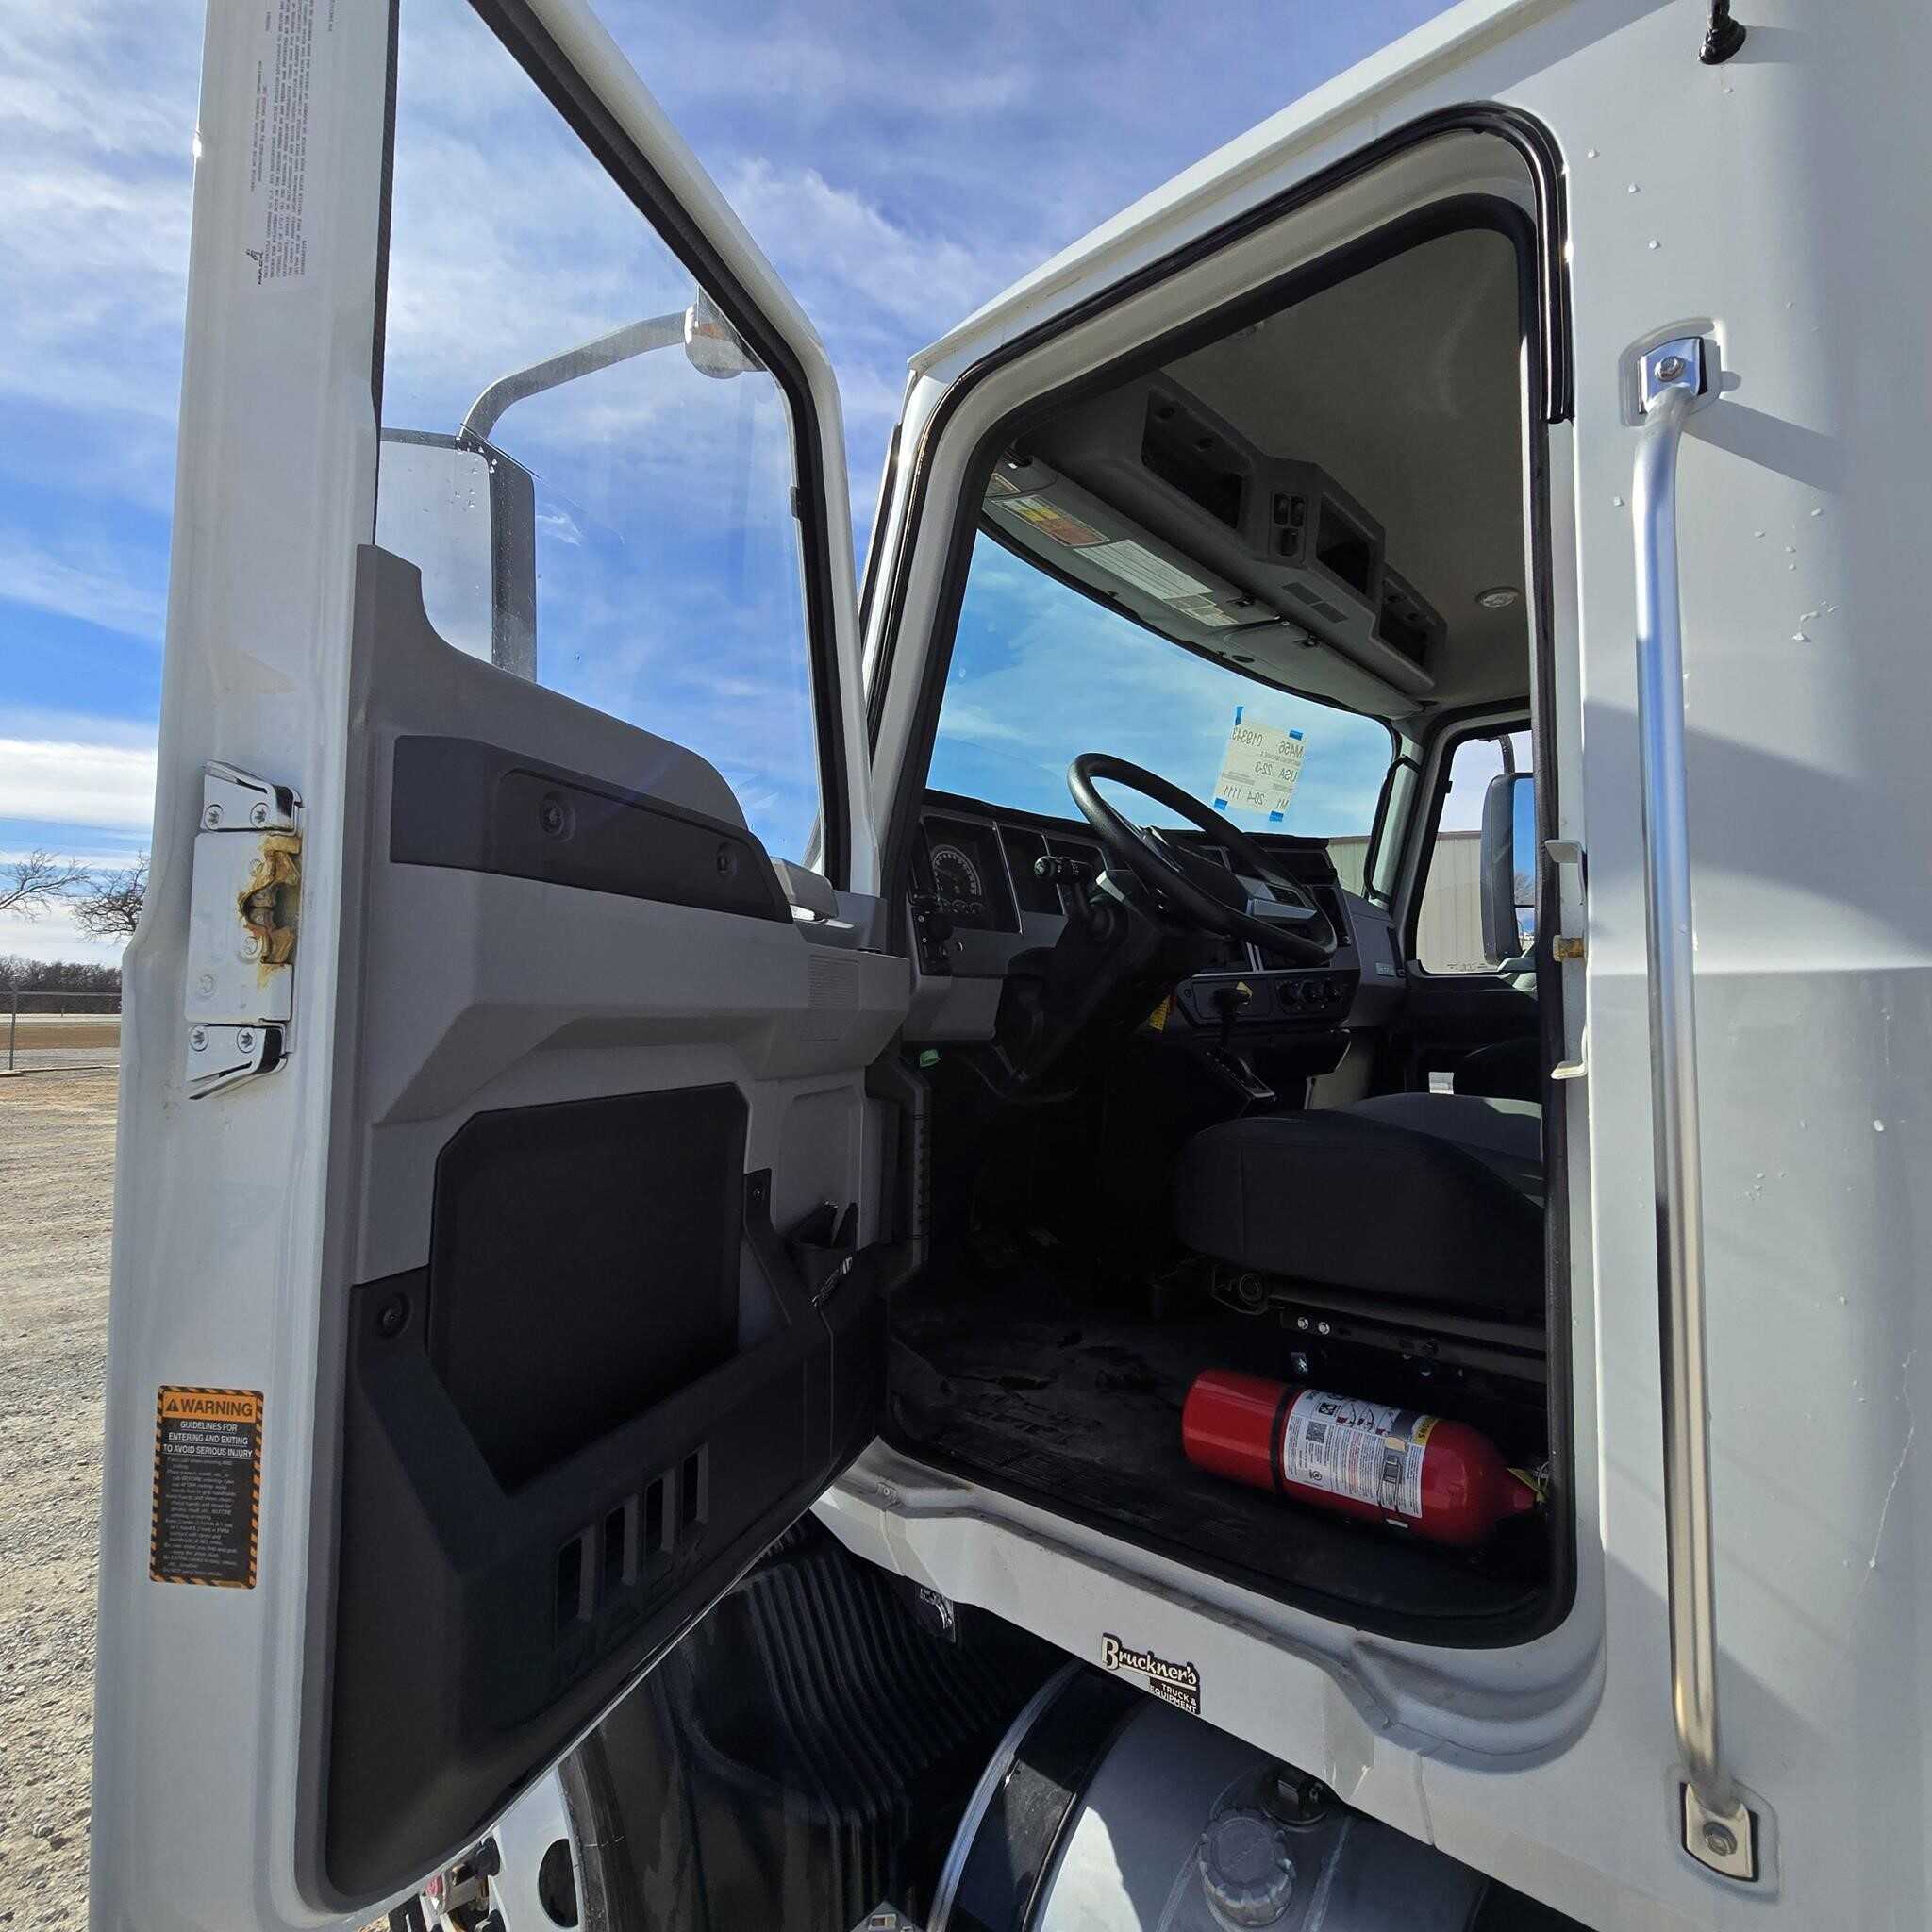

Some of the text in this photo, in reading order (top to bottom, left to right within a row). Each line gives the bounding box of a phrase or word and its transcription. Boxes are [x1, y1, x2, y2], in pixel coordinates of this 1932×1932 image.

[181, 1398, 253, 1417] WARNING
[180, 1421, 238, 1432] GUIDELINES FOR
[169, 1432, 248, 1445] ENTERING AND EXITING
[163, 1443, 253, 1457] TO AVOID SERIOUS INJURY
[1101, 1635, 1197, 1685] Bruckner's
[1150, 1685, 1197, 1714] EQUIPMENT
[1161, 1683, 1197, 1707] TRUCK &
